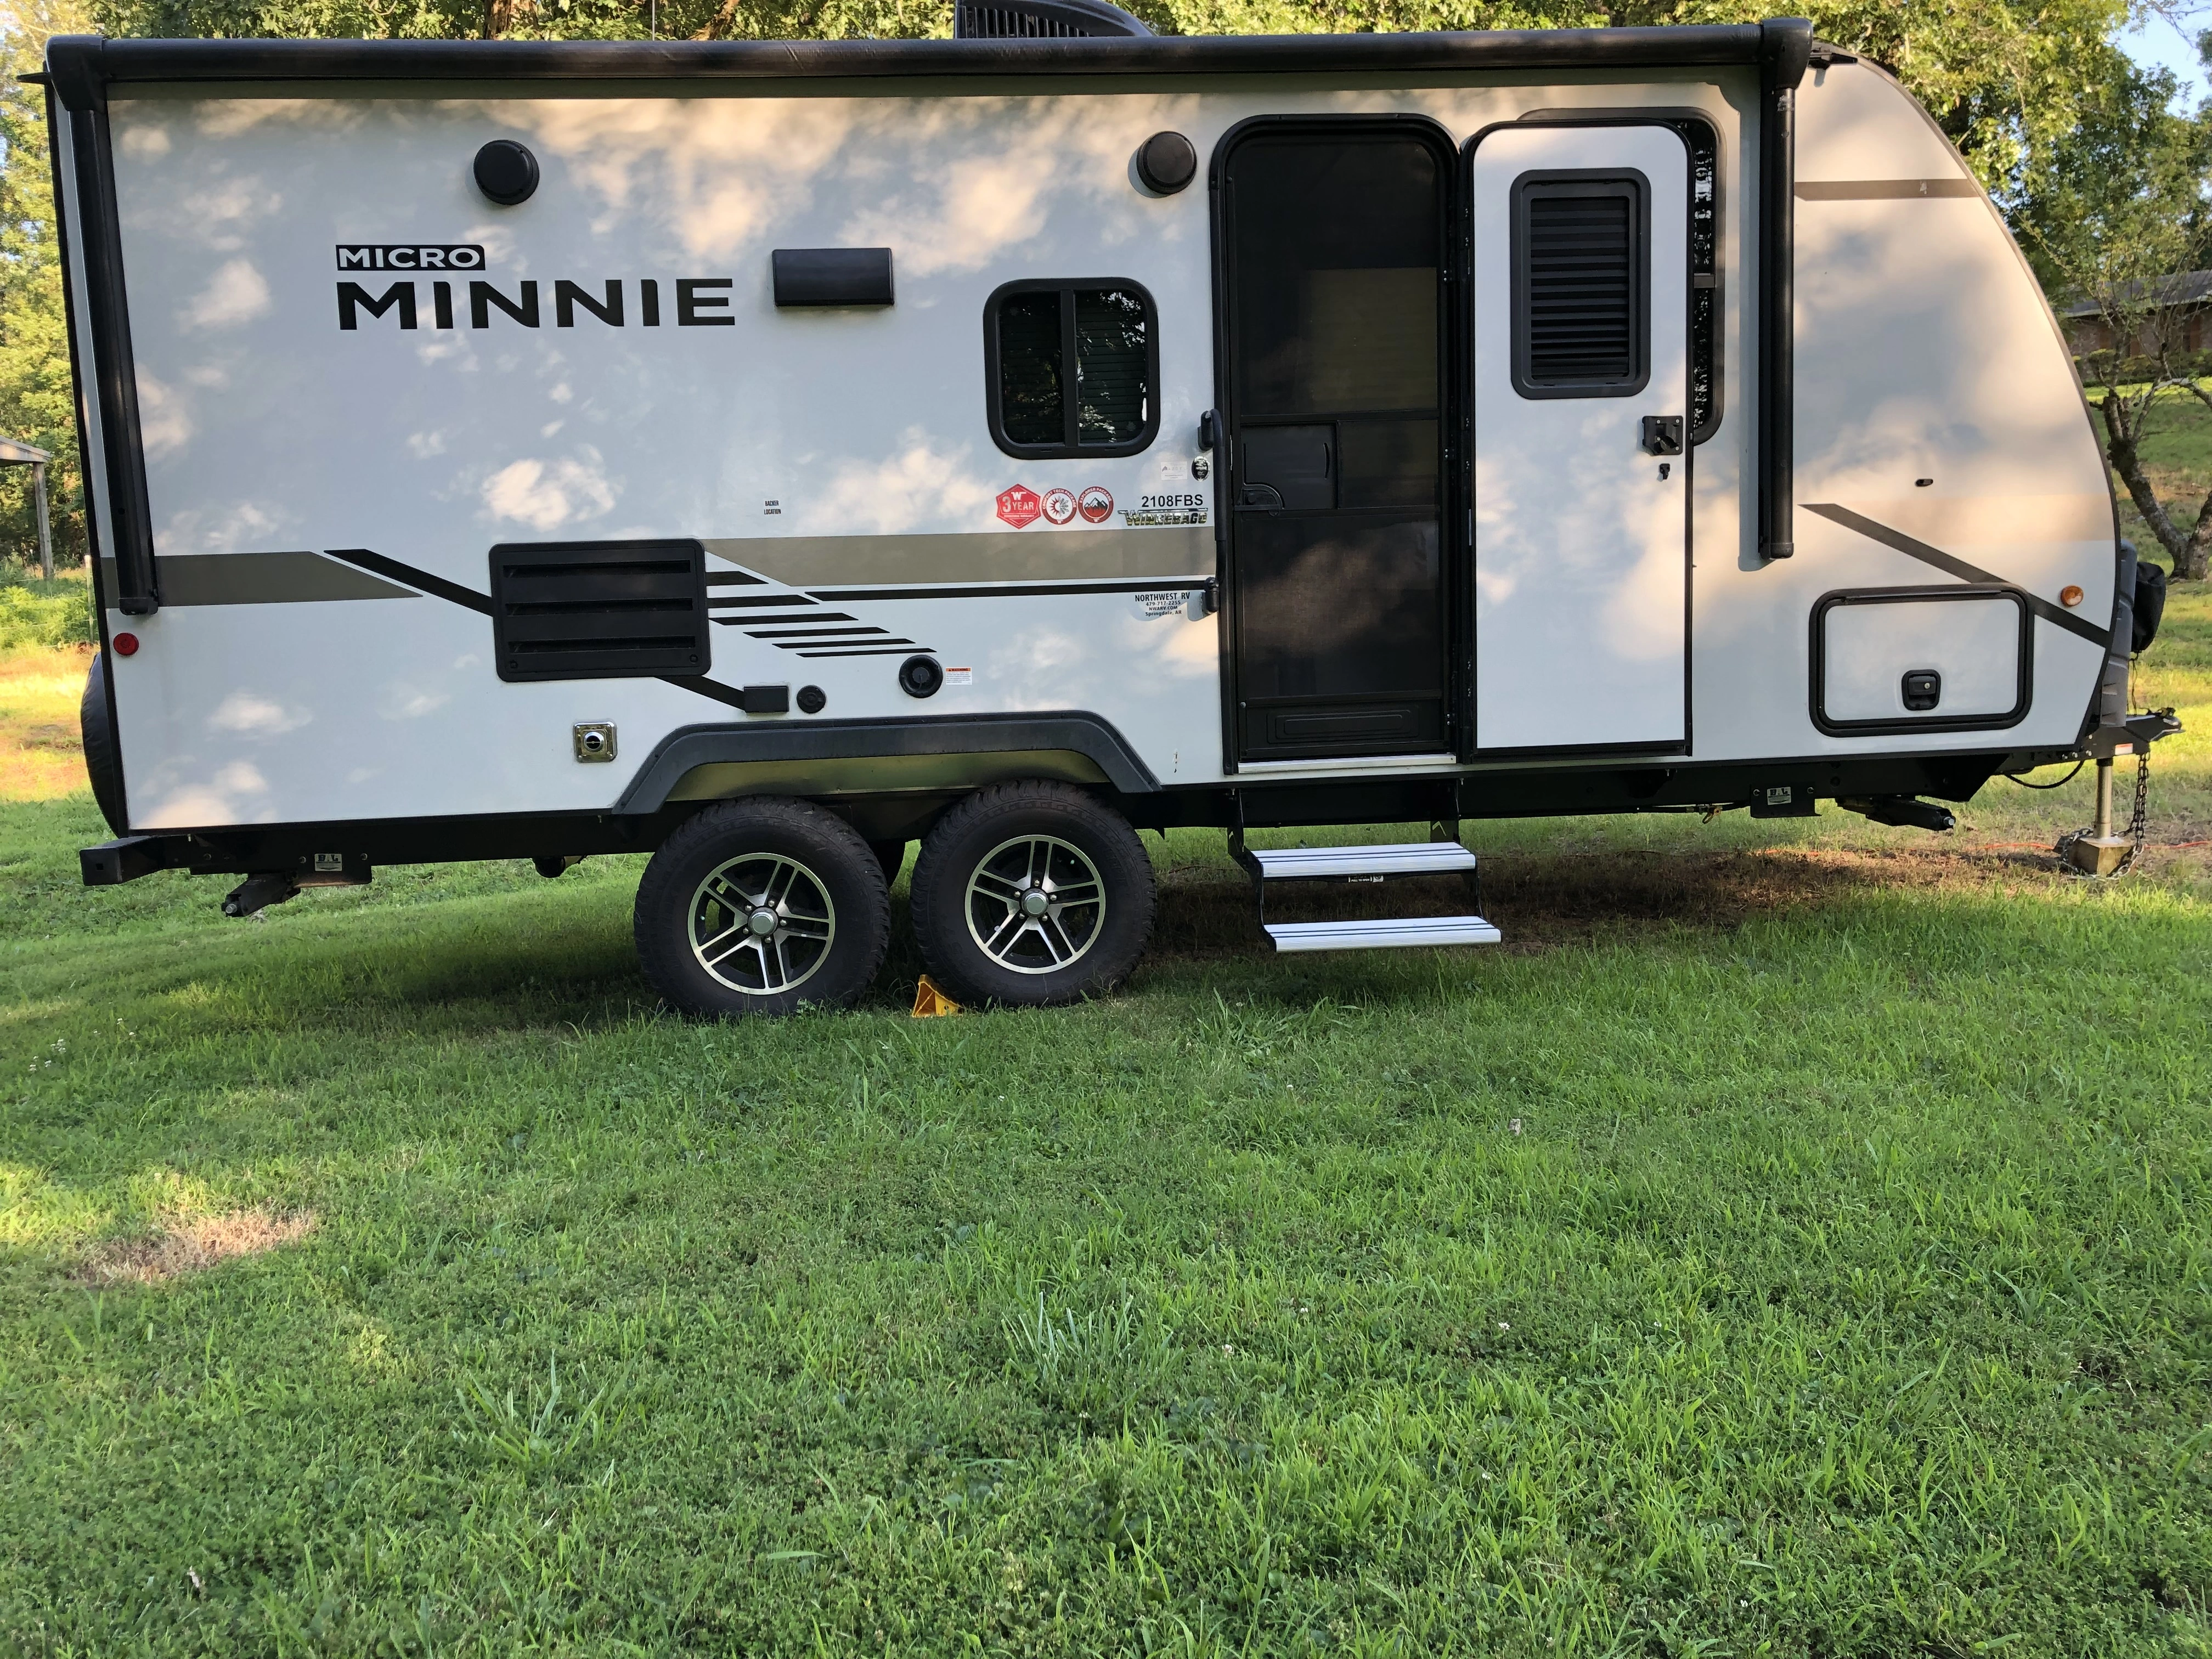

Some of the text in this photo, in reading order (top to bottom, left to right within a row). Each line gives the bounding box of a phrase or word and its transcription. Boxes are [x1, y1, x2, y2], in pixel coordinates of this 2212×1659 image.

[339, 248, 481, 268] MICRO
[336, 279, 735, 330] MINNIE
[1079, 488, 1113, 503] EXPLORER PACKAGE
[1141, 494, 1203, 507] 2108FBS
[1002, 496, 1034, 513] 3 YEAR
[1118, 507, 1208, 526] WINNEBAGO
[1135, 593, 1177, 602] NORTHWEST
